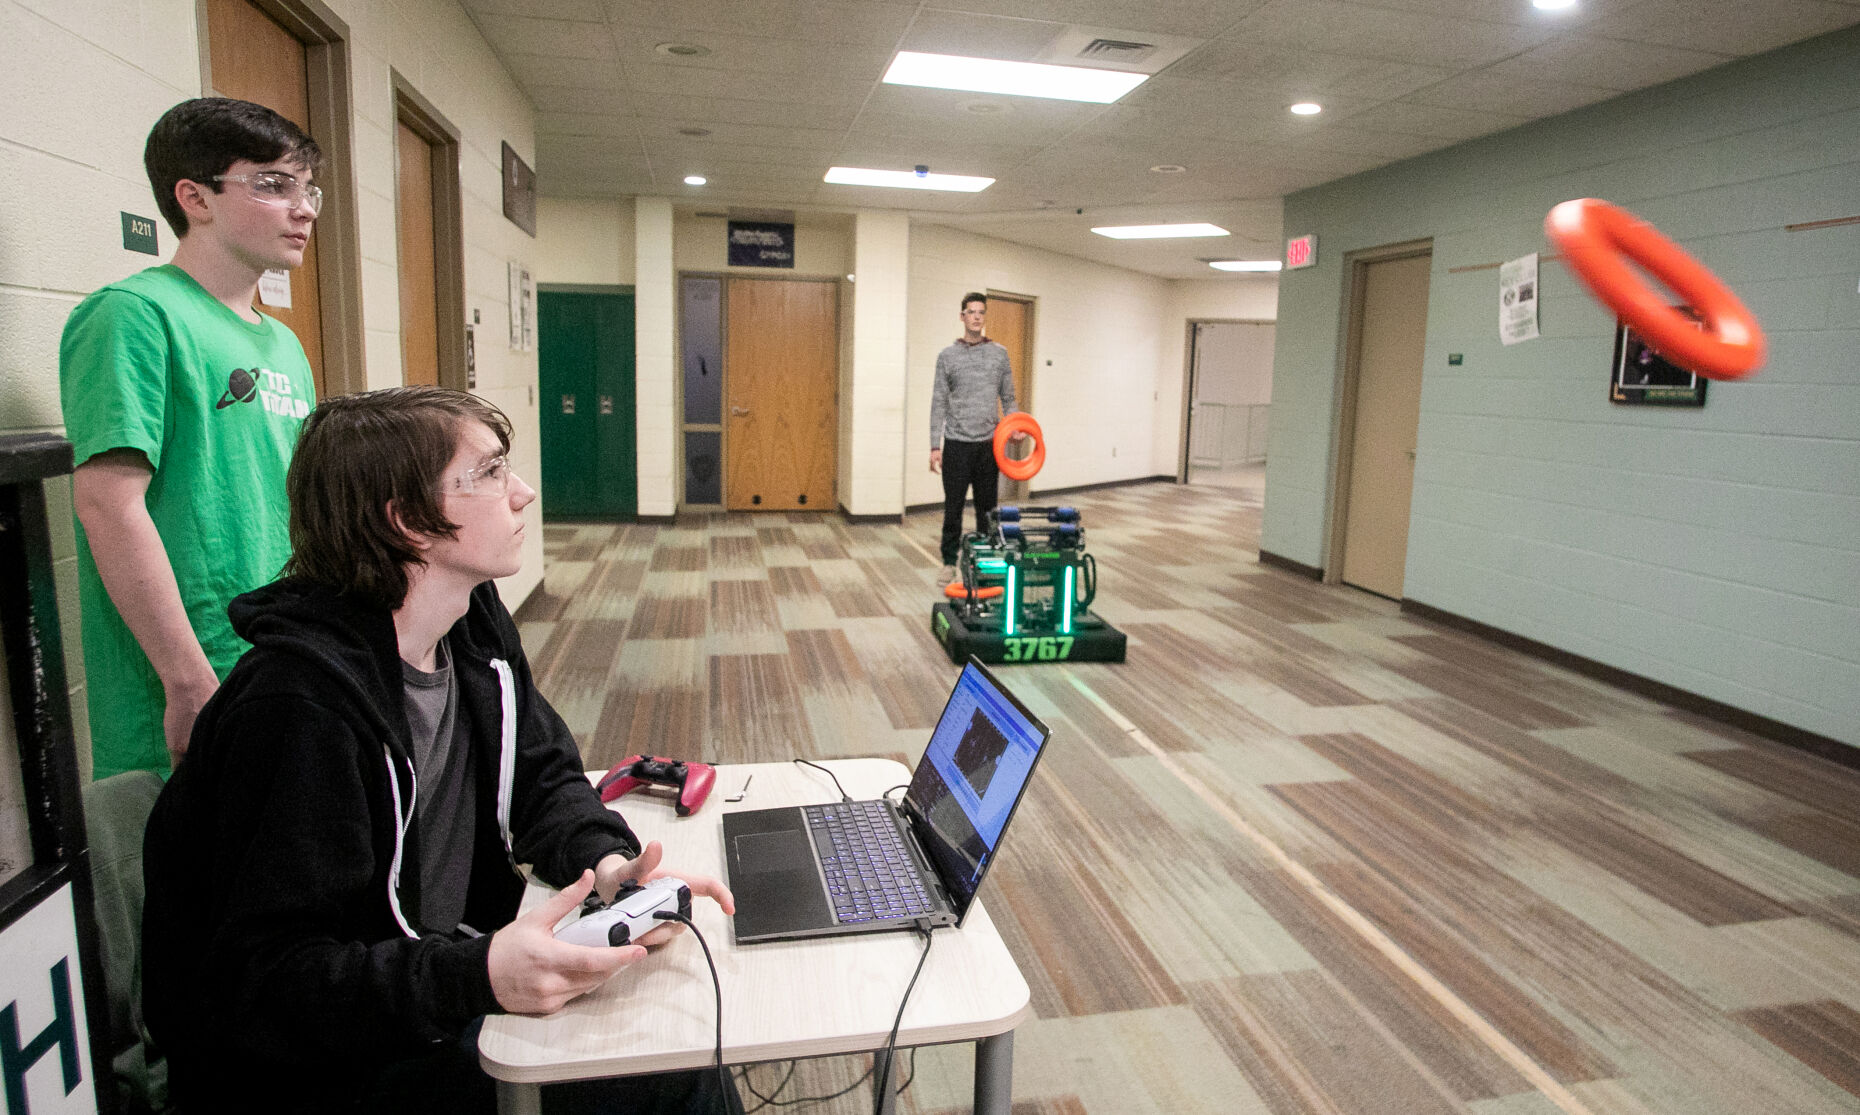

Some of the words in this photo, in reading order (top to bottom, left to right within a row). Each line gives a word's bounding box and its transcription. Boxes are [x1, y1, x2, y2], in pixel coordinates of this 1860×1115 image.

[131, 219, 152, 237] A211
[261, 368, 291, 394] TC
[1003, 637, 1074, 660] 3767
[0, 955, 82, 1115] H
